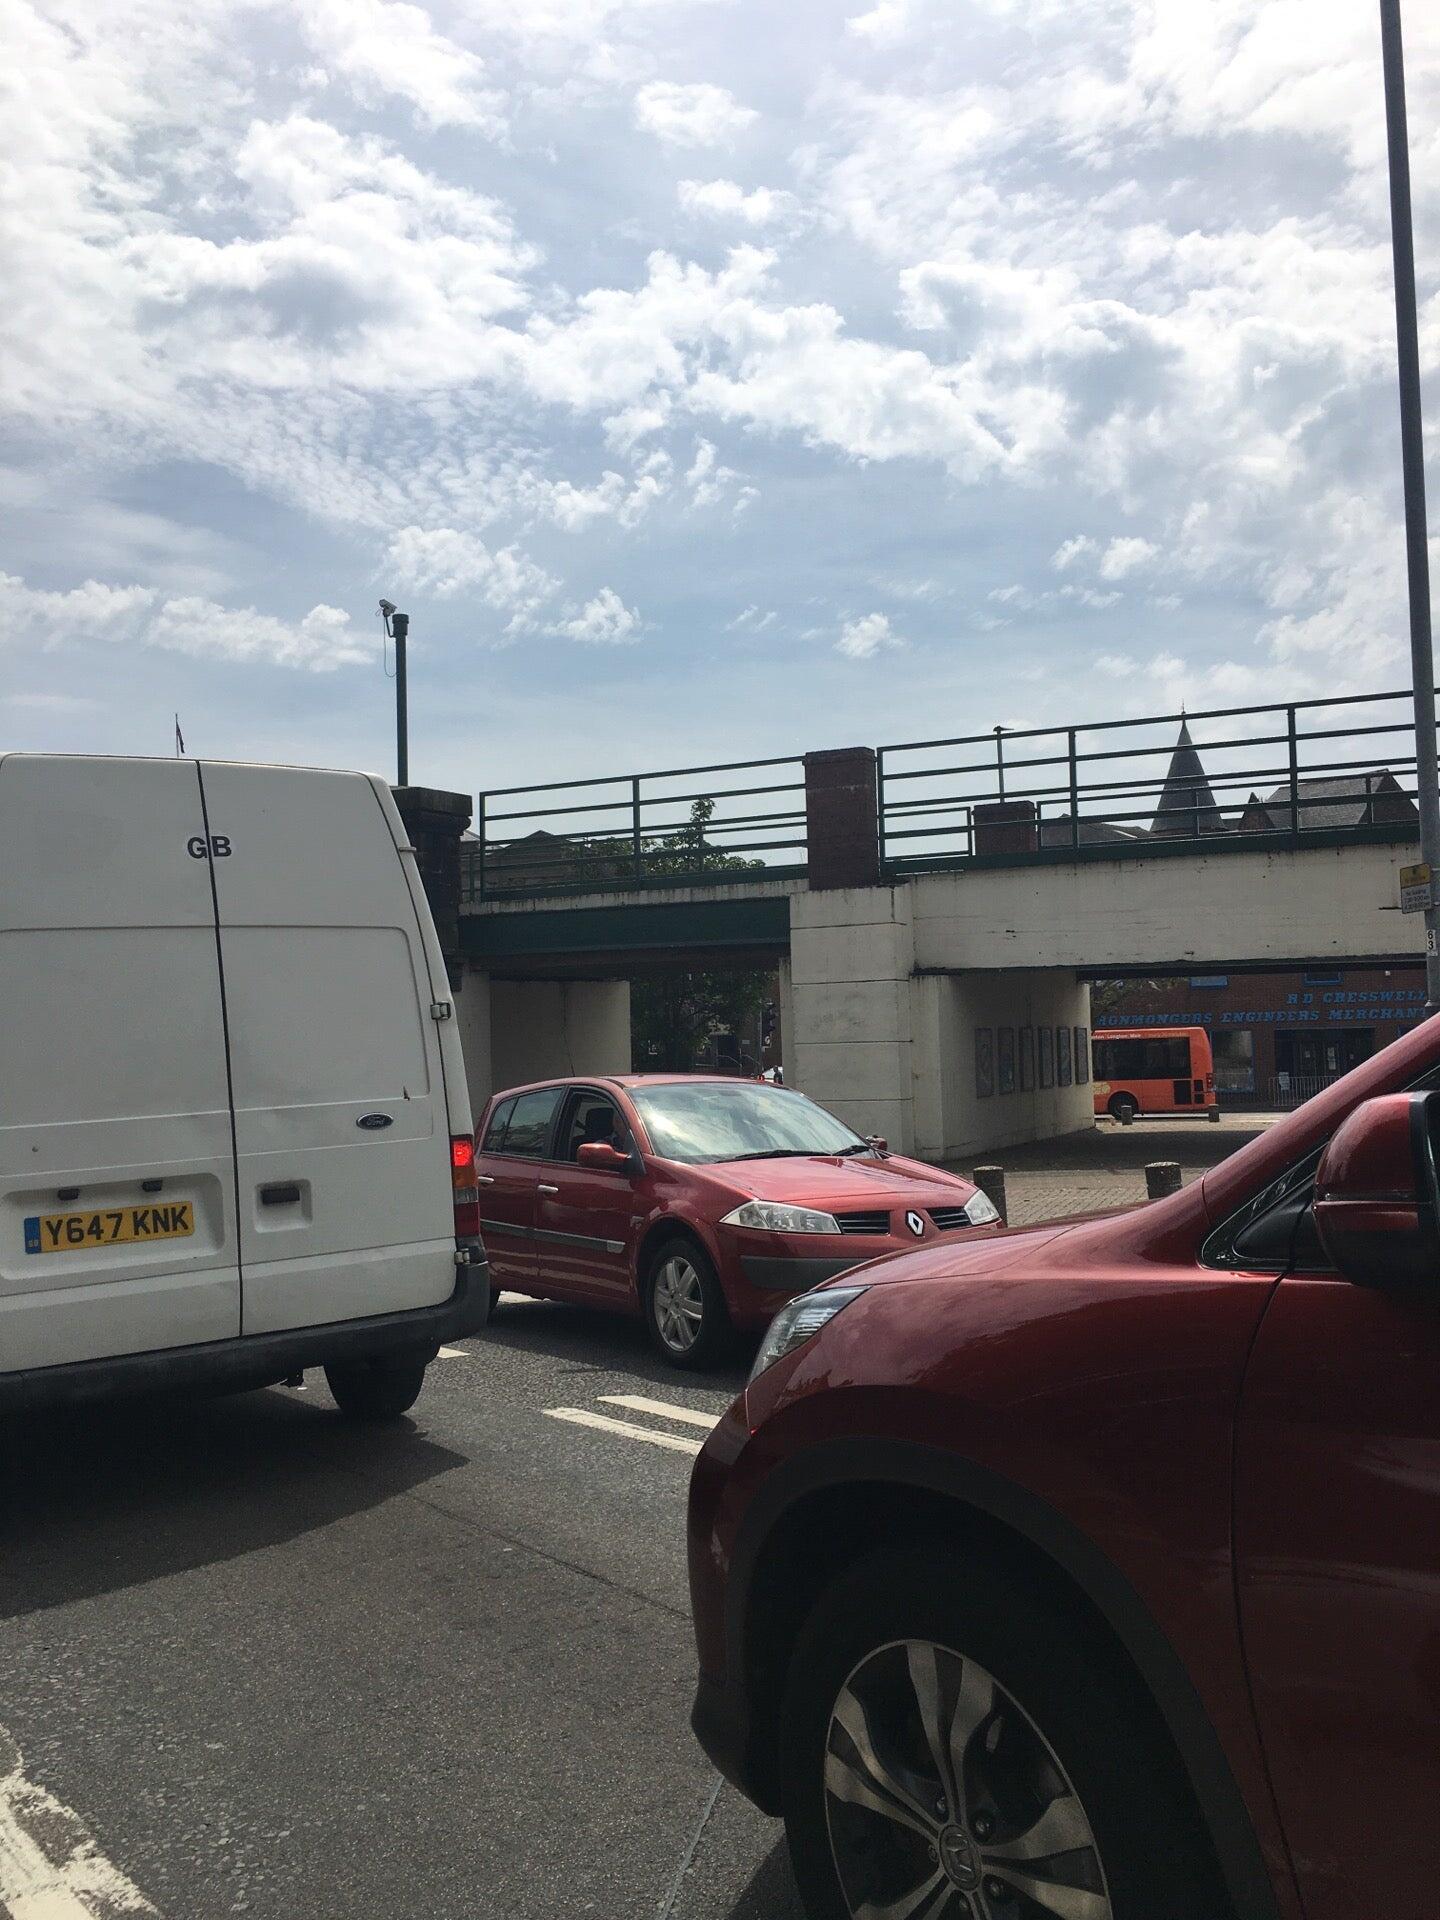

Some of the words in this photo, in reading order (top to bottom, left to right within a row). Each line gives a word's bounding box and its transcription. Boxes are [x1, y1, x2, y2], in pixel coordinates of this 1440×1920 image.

[187, 835, 232, 859] GB
[1097, 1013, 1212, 1026] RONMONGERS
[1221, 1010, 1320, 1022] ENGINEERS
[46, 1212, 123, 1246] Y647
[132, 1205, 189, 1236] KNK
